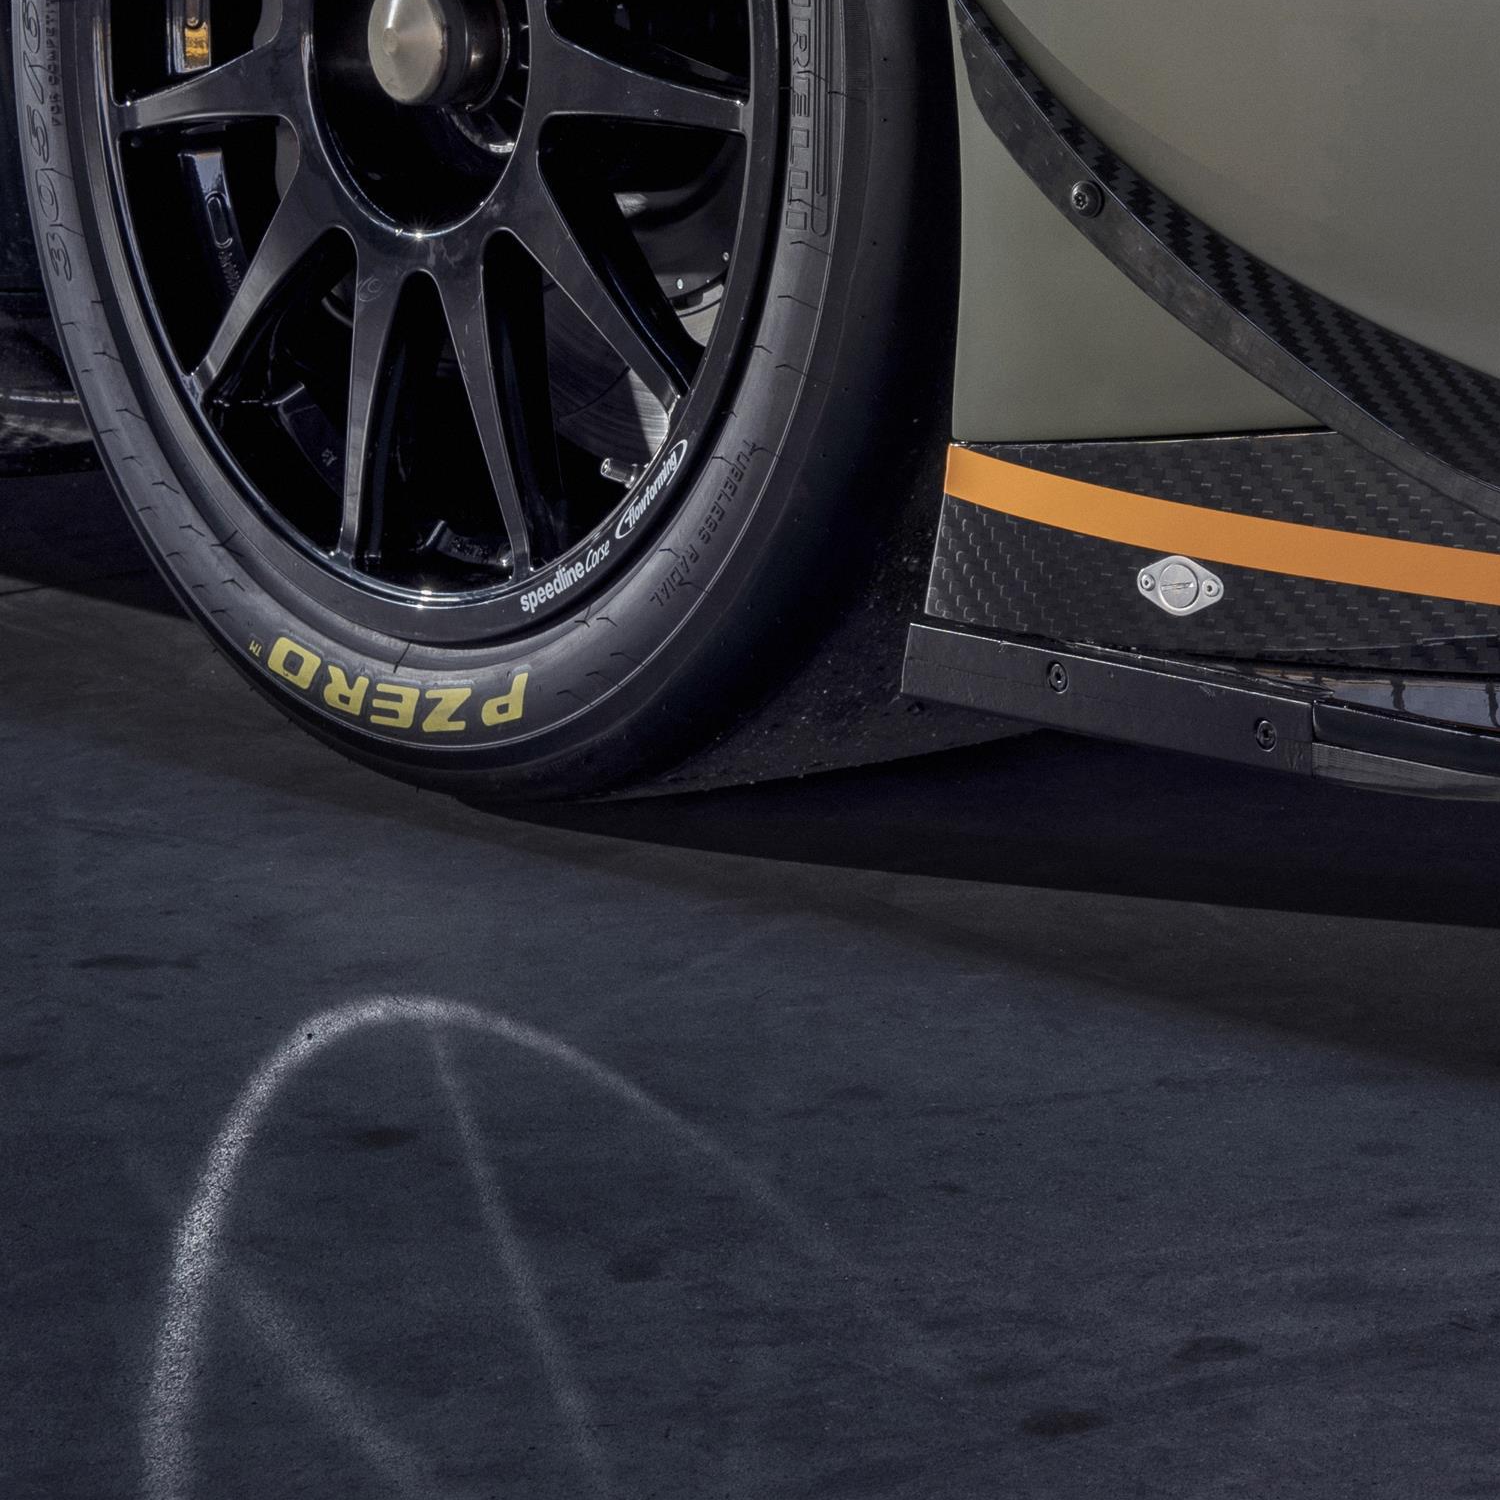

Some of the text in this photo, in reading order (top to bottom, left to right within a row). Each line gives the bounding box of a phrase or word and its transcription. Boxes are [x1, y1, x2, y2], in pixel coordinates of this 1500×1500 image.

[624, 449, 678, 529] flowforming
[649, 440, 756, 607] TUBELESS RADIAL
[519, 539, 611, 614] speedline Corse
